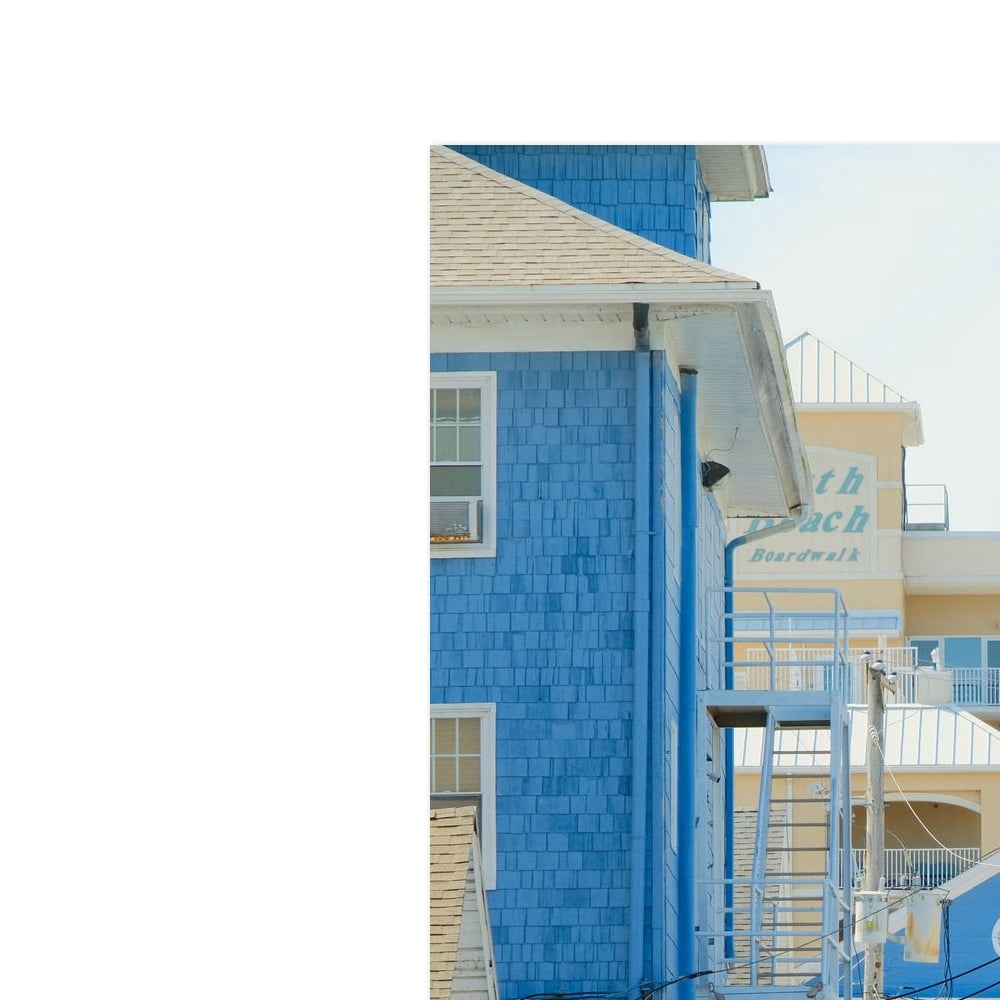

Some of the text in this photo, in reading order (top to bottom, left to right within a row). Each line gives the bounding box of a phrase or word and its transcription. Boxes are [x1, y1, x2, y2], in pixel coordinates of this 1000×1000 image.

[813, 467, 864, 494] th
[744, 505, 871, 534] ach
[749, 548, 861, 562] Boardwalk
